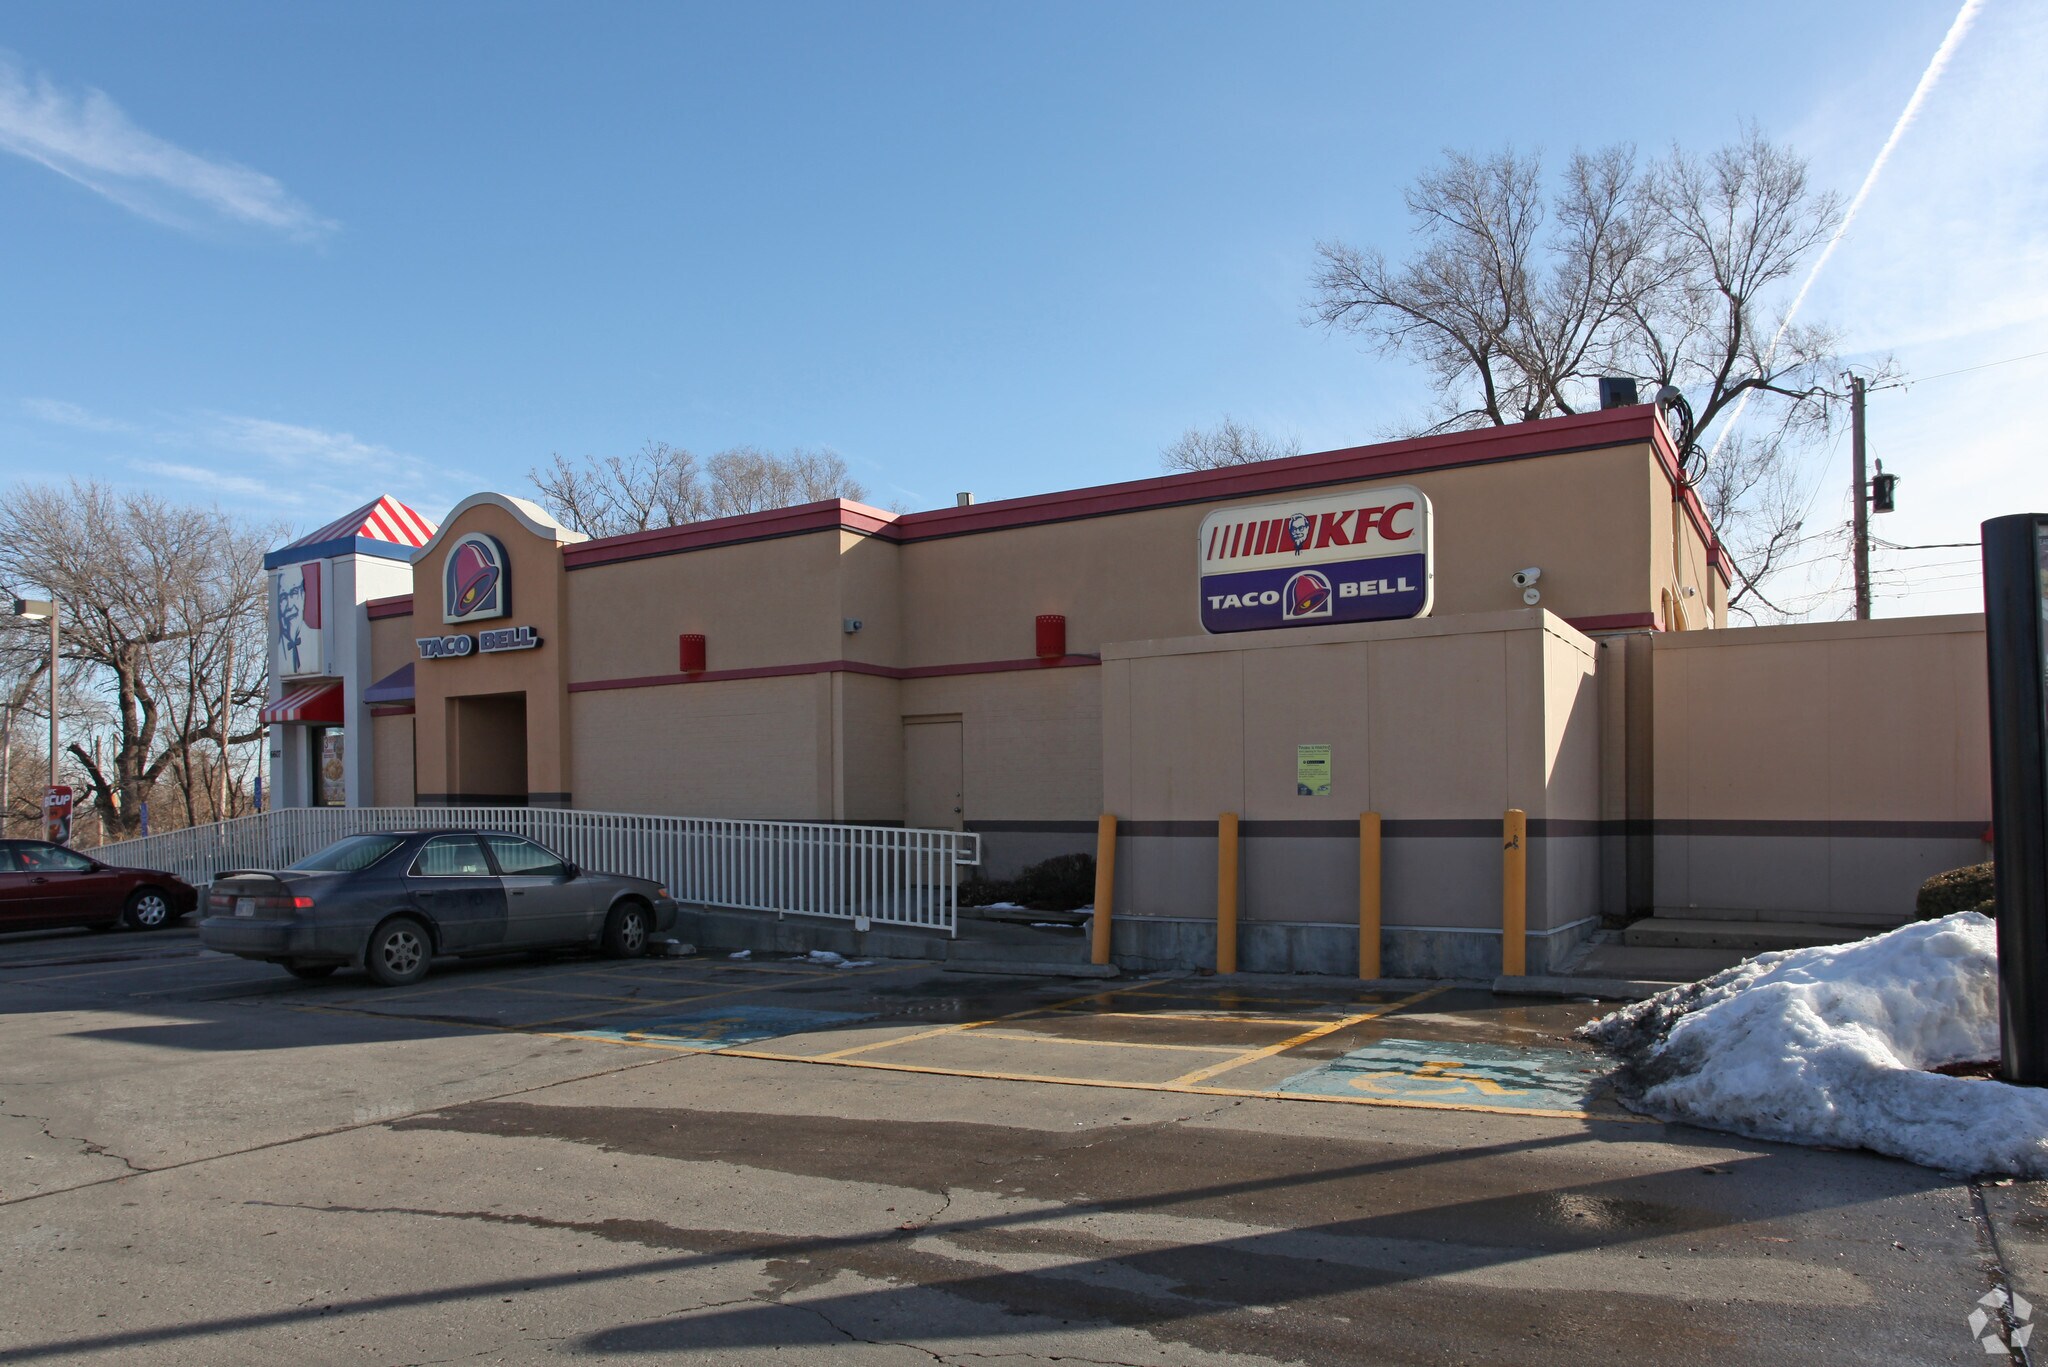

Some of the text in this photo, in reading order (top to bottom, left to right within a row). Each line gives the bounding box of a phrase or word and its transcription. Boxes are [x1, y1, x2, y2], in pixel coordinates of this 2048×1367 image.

[1315, 501, 1415, 549] KFC
[1207, 577, 1415, 610] TACO BELL
[417, 626, 536, 658] TACO BELL
